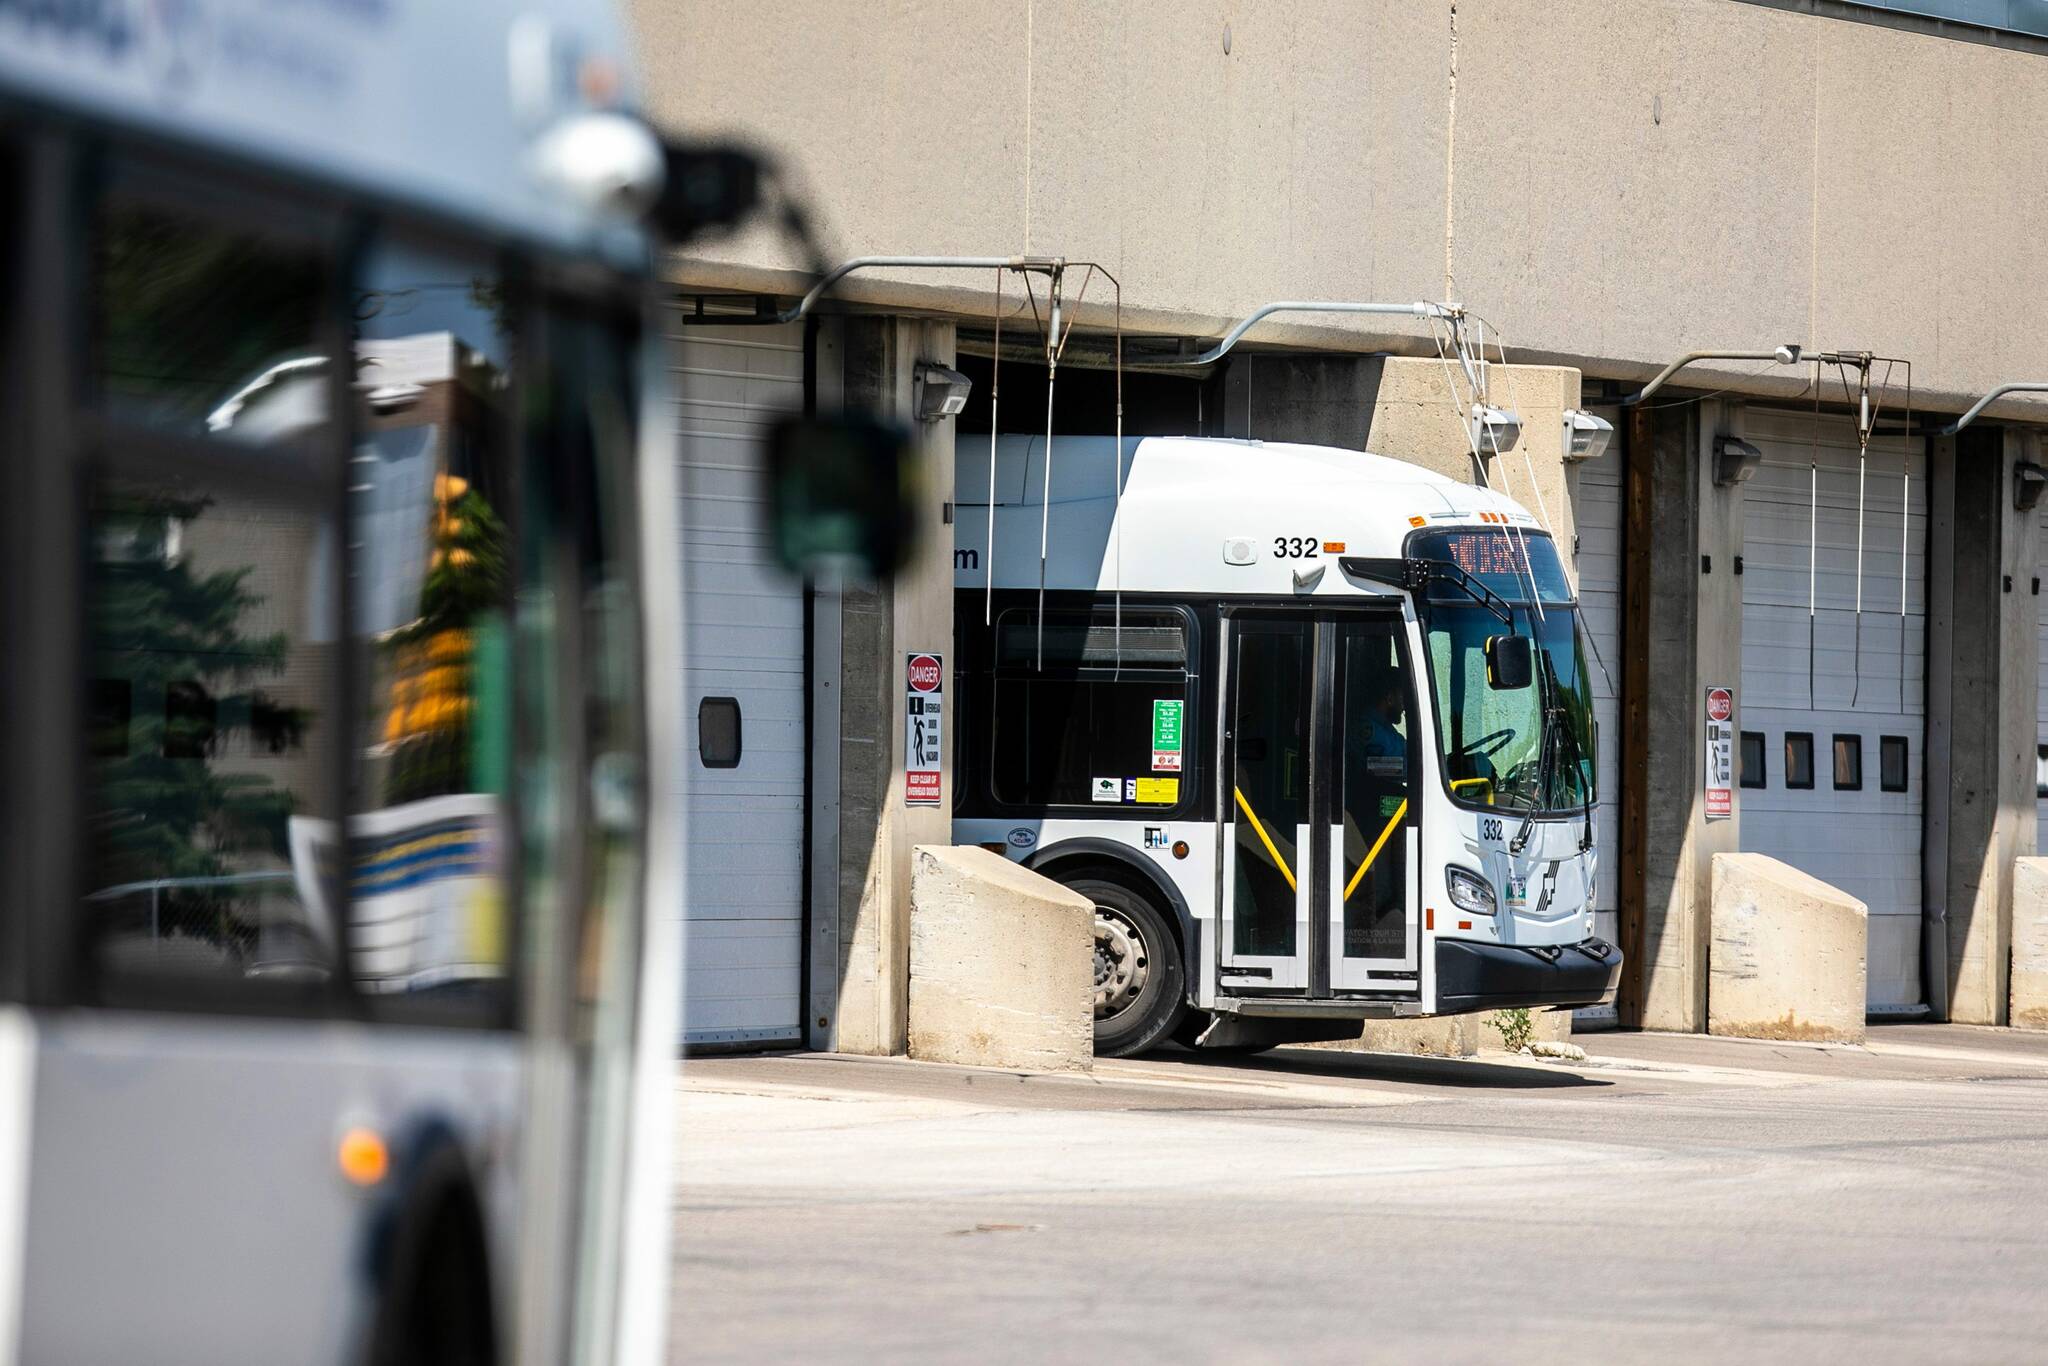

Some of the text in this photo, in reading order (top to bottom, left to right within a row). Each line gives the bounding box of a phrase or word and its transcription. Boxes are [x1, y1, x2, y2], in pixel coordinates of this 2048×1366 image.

[1273, 537, 1318, 558] 332
[910, 666, 938, 683] DANGER
[1709, 698, 1730, 713] DANGER
[1484, 819, 1502, 840] 332
